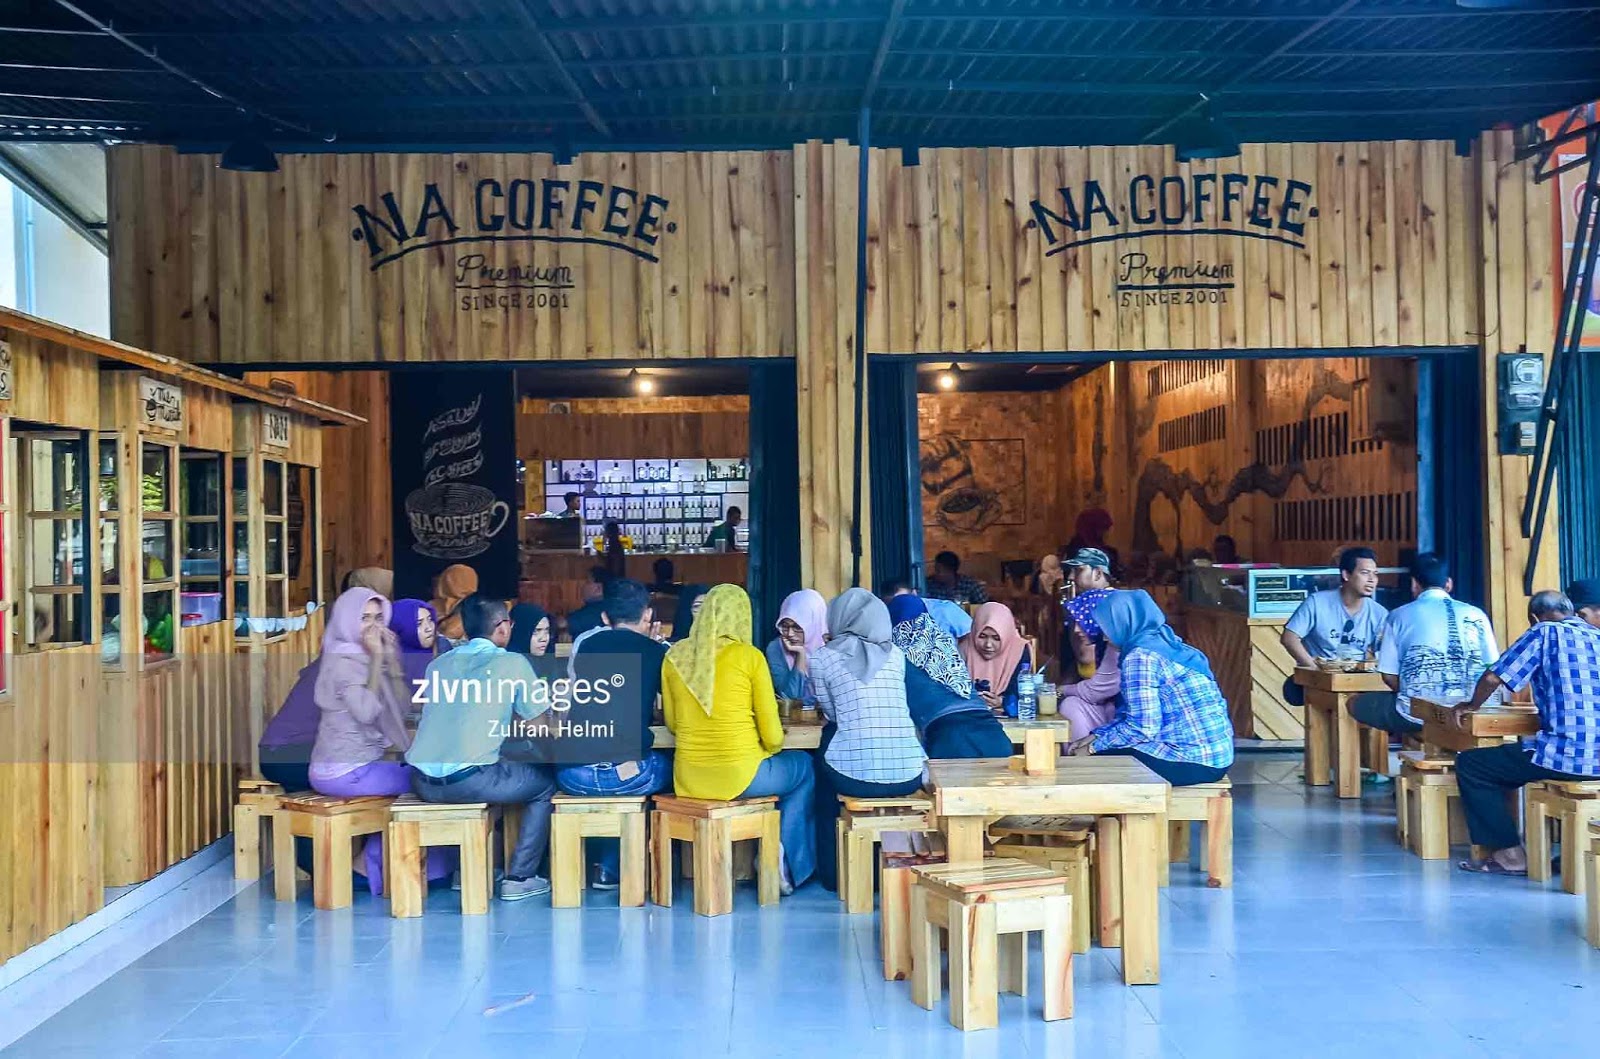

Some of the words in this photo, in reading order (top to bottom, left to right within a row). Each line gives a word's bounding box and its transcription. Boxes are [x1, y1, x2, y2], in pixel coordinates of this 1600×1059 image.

[352, 183, 460, 257] NA
[475, 178, 670, 246] COFFEE
[1029, 180, 1119, 245] NA
[1129, 173, 1312, 237] COFFEE
[455, 254, 573, 283] Premium
[1119, 252, 1234, 282] Premium
[461, 294, 520, 312] SINCE
[526, 294, 569, 310] 2001
[1120, 291, 1181, 307] SINCE
[1185, 290, 1228, 305] 2001
[434, 510, 489, 535] COFFEE
